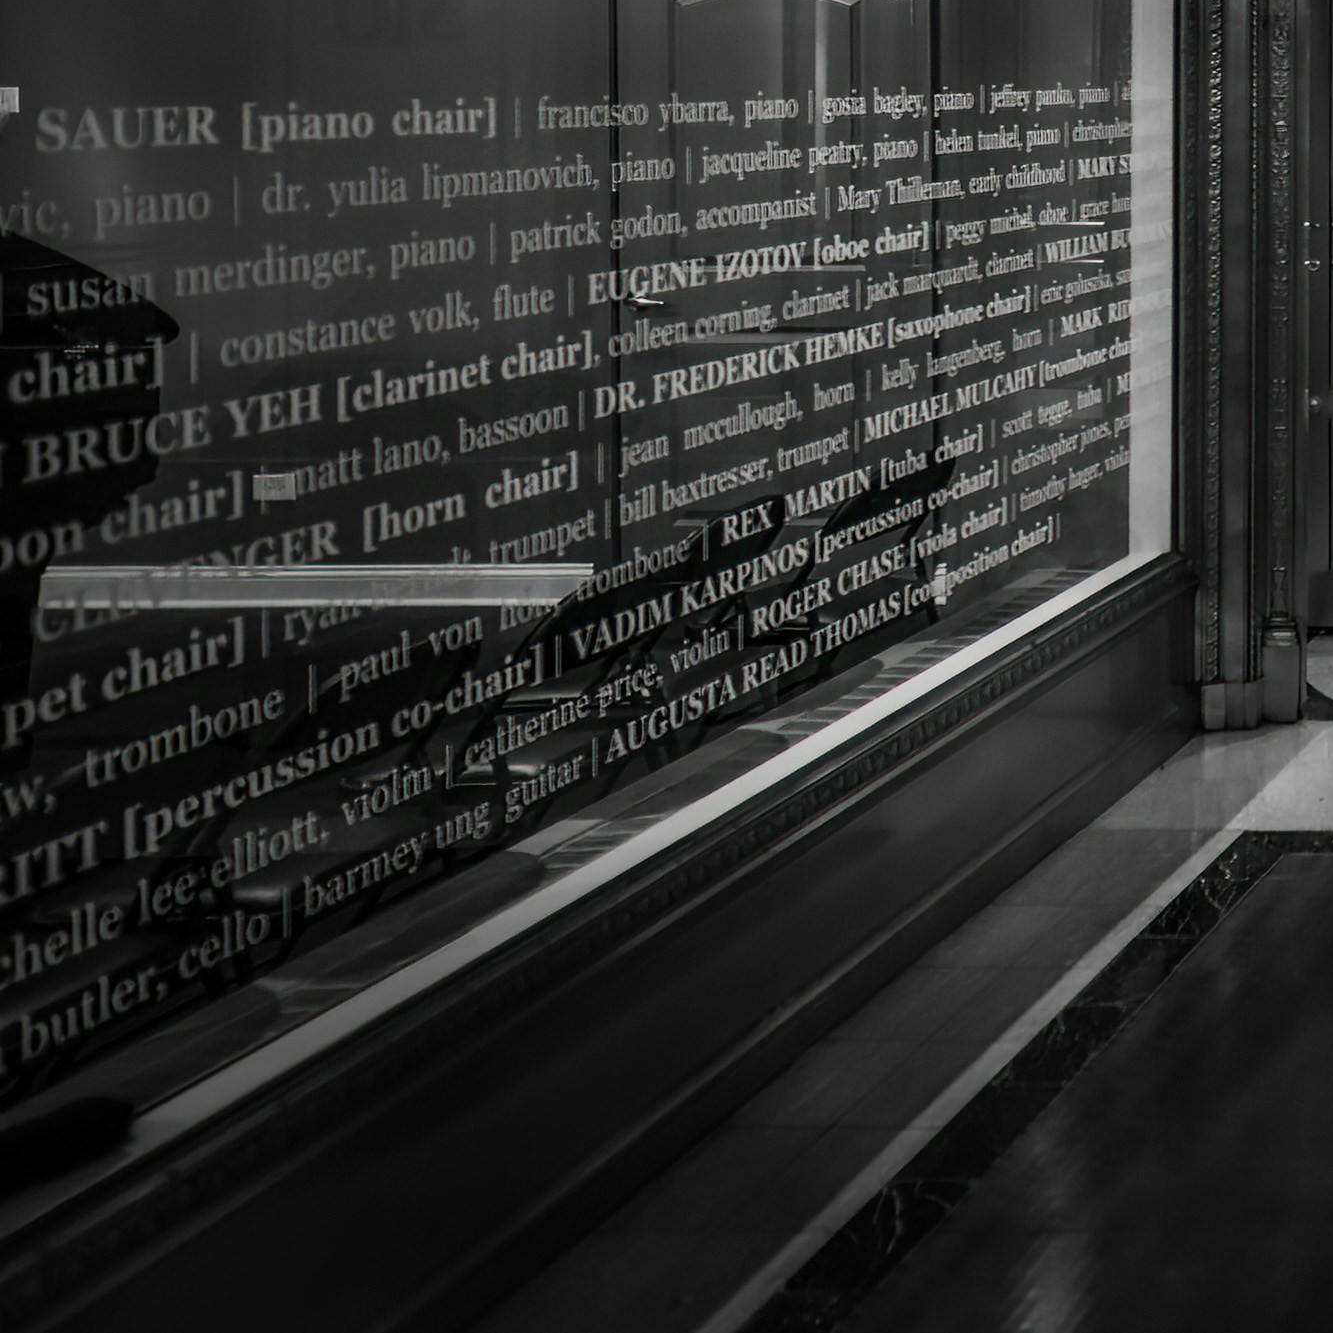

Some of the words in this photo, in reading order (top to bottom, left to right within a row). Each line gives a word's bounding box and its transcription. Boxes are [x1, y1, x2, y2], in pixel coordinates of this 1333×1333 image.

[35, 106, 219, 153] SAUER
[241, 101, 375, 154] [piano
[392, 97, 496, 139] chair]
[537, 95, 649, 130] francisco
[658, 92, 735, 132] ybarra,
[744, 90, 799, 128] piano
[933, 86, 975, 118] piano
[95, 183, 212, 241] piano
[261, 172, 311, 215] dr.
[327, 166, 408, 218] yulia
[421, 153, 600, 209] lipmanovich,
[611, 151, 676, 192] piano
[699, 140, 803, 184] jacqueline
[873, 133, 919, 168] piano
[7, 333, 165, 405] chair]
[220, 313, 396, 368] constance
[409, 290, 480, 334] volk,
[494, 283, 555, 321] flute
[588, 257, 707, 305] EUGENE
[714, 241, 807, 284] IZOTOV
[814, 234, 870, 270] [oboe
[875, 221, 929, 255] chair]
[21, 405, 213, 484] BRUCE
[222, 383, 322, 439] YEH
[337, 353, 493, 423] [clarinet
[608, 317, 689, 358] colleen
[783, 284, 850, 320] clarinet
[864, 271, 900, 311] jack
[1045, 232, 1108, 263] WILLIAM
[26, 271, 153, 317] susan
[175, 243, 376, 297] merdinger,
[390, 230, 476, 280] piano
[509, 211, 602, 264] patrick
[610, 205, 688, 250] godon,
[696, 189, 818, 230] accompanist
[837, 185, 882, 214] Mary
[102, 470, 244, 545] chair]
[293, 447, 364, 496] matt
[458, 402, 568, 454] bassoon
[594, 380, 646, 418] DR.
[652, 340, 800, 405] FREDERICK
[805, 321, 885, 366] HEMKE
[888, 304, 984, 349] [saxophone
[102, 616, 245, 701] chair]
[490, 509, 598, 564] trumpet
[619, 483, 657, 527] bill
[777, 427, 850, 472] trumpet
[863, 393, 953, 444] MICHAEL
[956, 364, 1037, 412] MULCAHY
[362, 492, 466, 553] [horn
[485, 450, 578, 509] chair]
[618, 435, 670, 478] jean
[813, 382, 855, 412] horn
[1061, 306, 1103, 338] MARK
[85, 688, 285, 788] trombone
[338, 628, 411, 704] paul
[425, 616, 484, 657] von
[720, 500, 776, 548] REX
[784, 465, 872, 522] MARTIN
[880, 448, 929, 491] [tuba
[935, 423, 984, 464] chair]
[123, 721, 381, 860] [percussion
[391, 642, 545, 739] co-chair]
[569, 590, 676, 661] VADIM
[680, 537, 811, 617] KARPINOS
[815, 497, 925, 564] [percussion
[19, 965, 169, 1064] butler,
[178, 908, 271, 980] cello
[504, 753, 585, 823] guitar
[604, 671, 738, 766] AUGUSTA
[741, 635, 809, 695] READ
[810, 590, 901, 658] THOMAS
[903, 544, 1010, 617] [coposition
[137, 870, 199, 928] lee
[464, 692, 590, 768] catherine
[671, 626, 730, 673] violin
[752, 575, 834, 638] ROGER
[837, 543, 907, 597] CHASE
